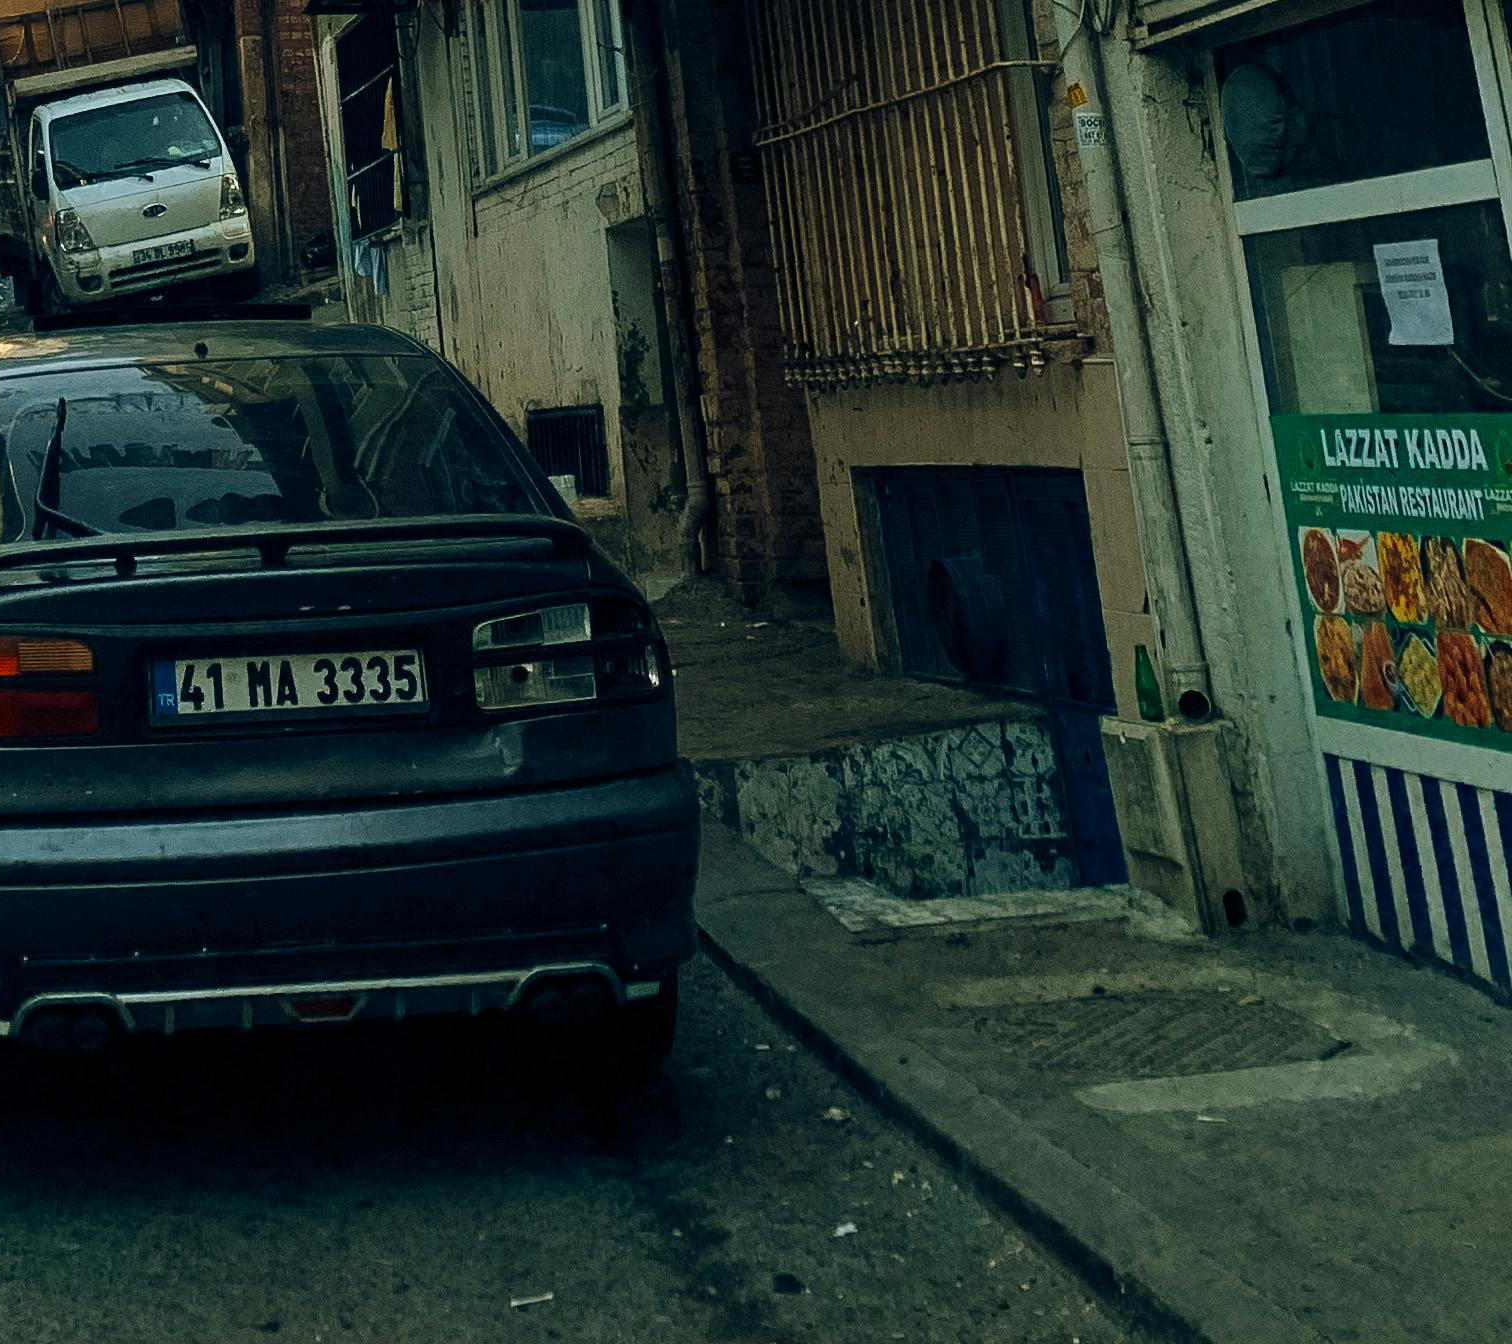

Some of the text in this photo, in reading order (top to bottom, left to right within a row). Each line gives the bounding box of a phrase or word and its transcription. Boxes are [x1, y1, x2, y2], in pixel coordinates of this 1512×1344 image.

[1320, 428, 1489, 471] LAZZAT KADDA
[1290, 480, 1315, 492] LAZZAT
[1339, 478, 1485, 521] PAKİSTAN RESTAURANT
[1484, 488, 1512, 502] LAZZA
[157, 653, 419, 711] TR 41 MA 3335
